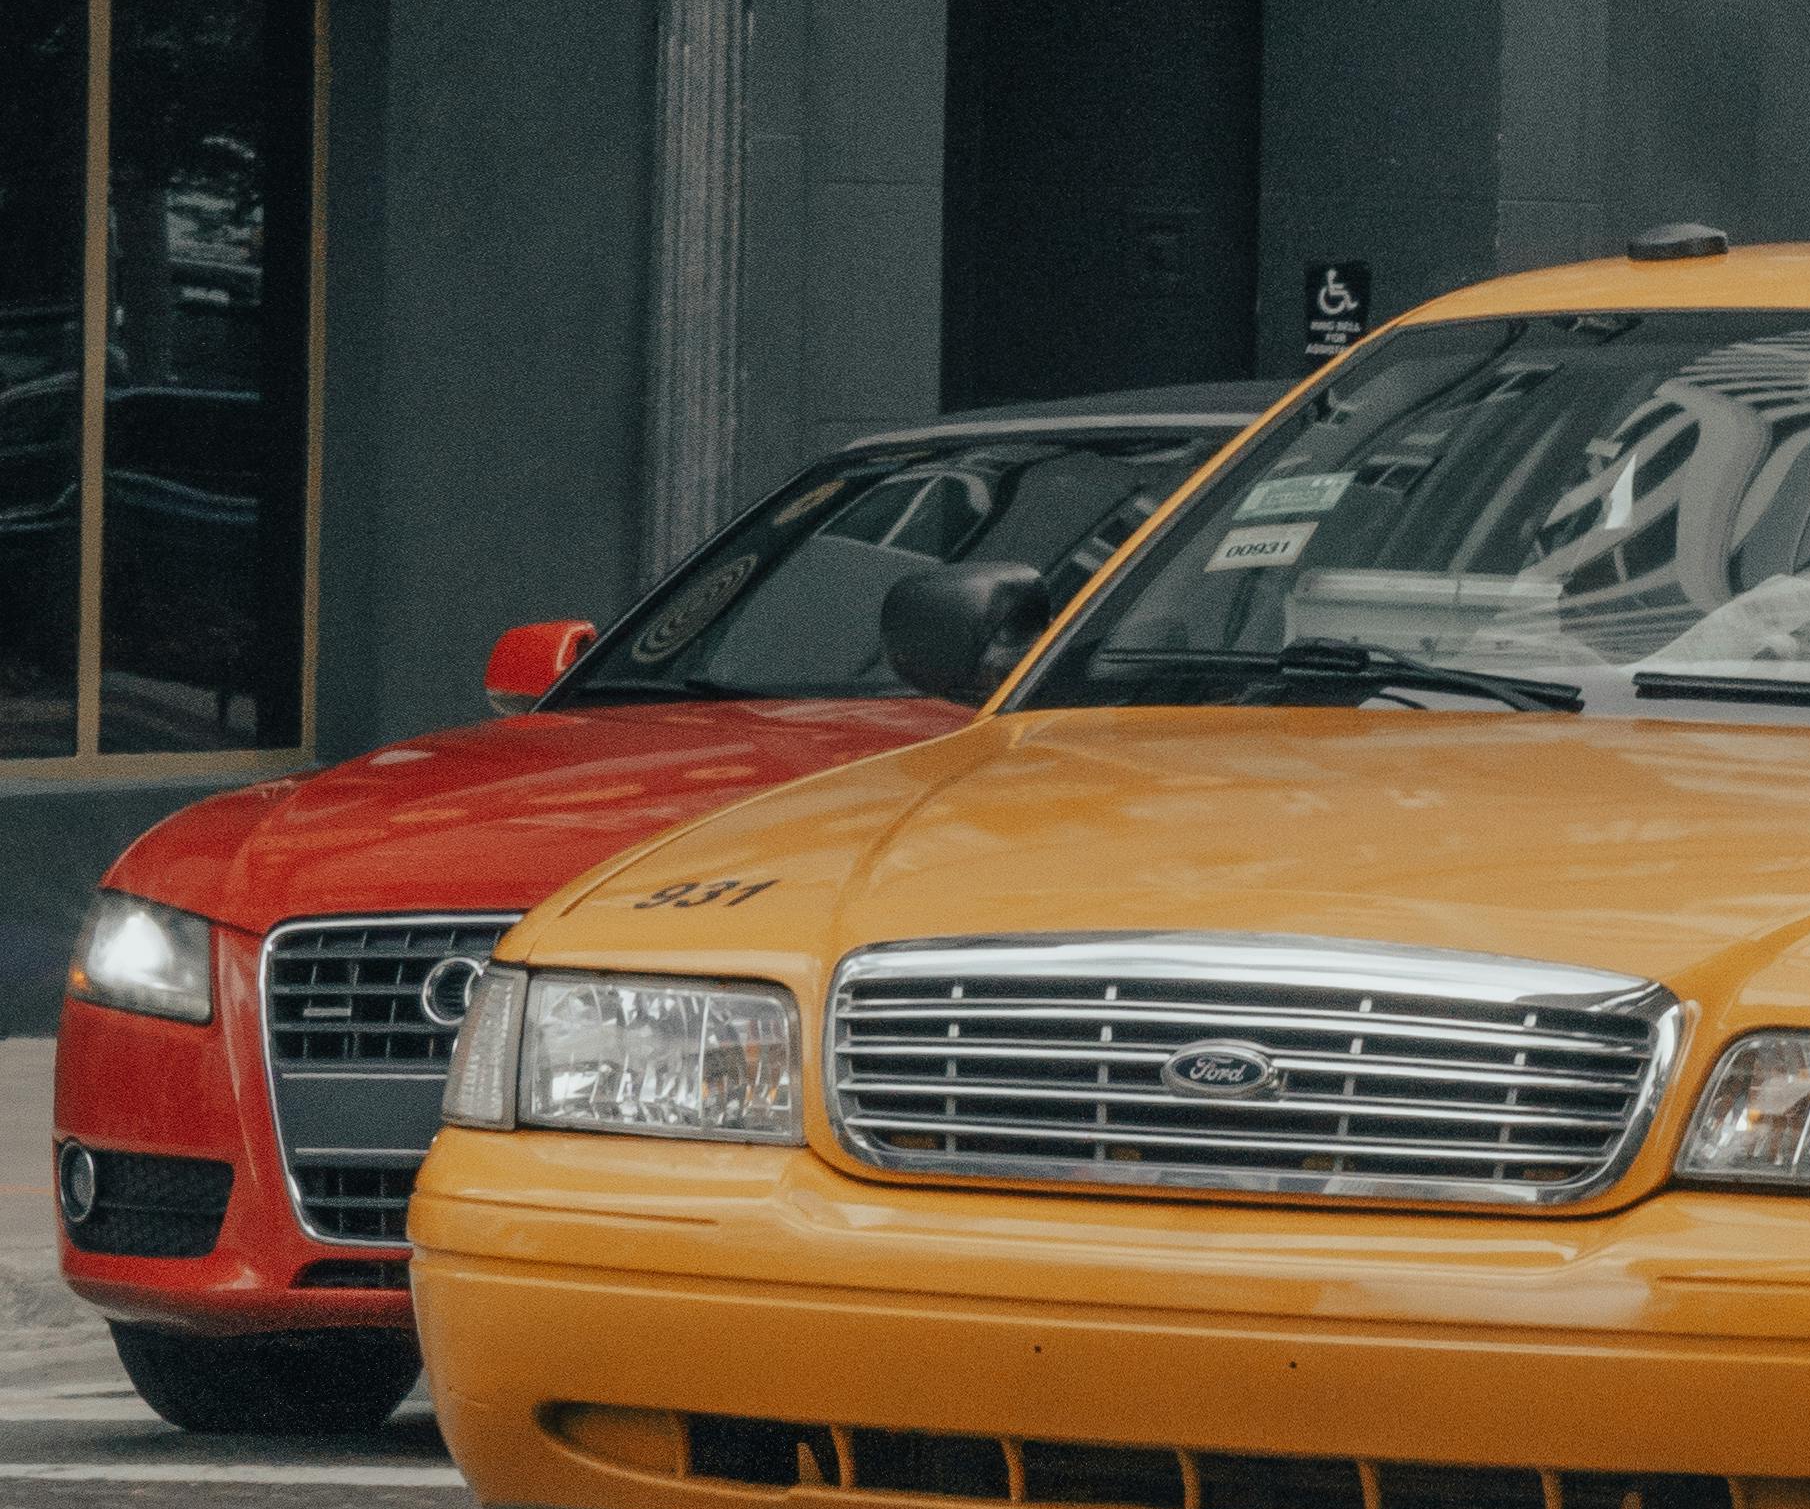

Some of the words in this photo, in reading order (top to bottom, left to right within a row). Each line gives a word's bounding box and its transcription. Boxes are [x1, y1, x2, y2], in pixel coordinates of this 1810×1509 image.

[1225, 540, 1291, 559] 00931
[633, 878, 780, 910] 931
[1189, 1056, 1248, 1082] Ford
